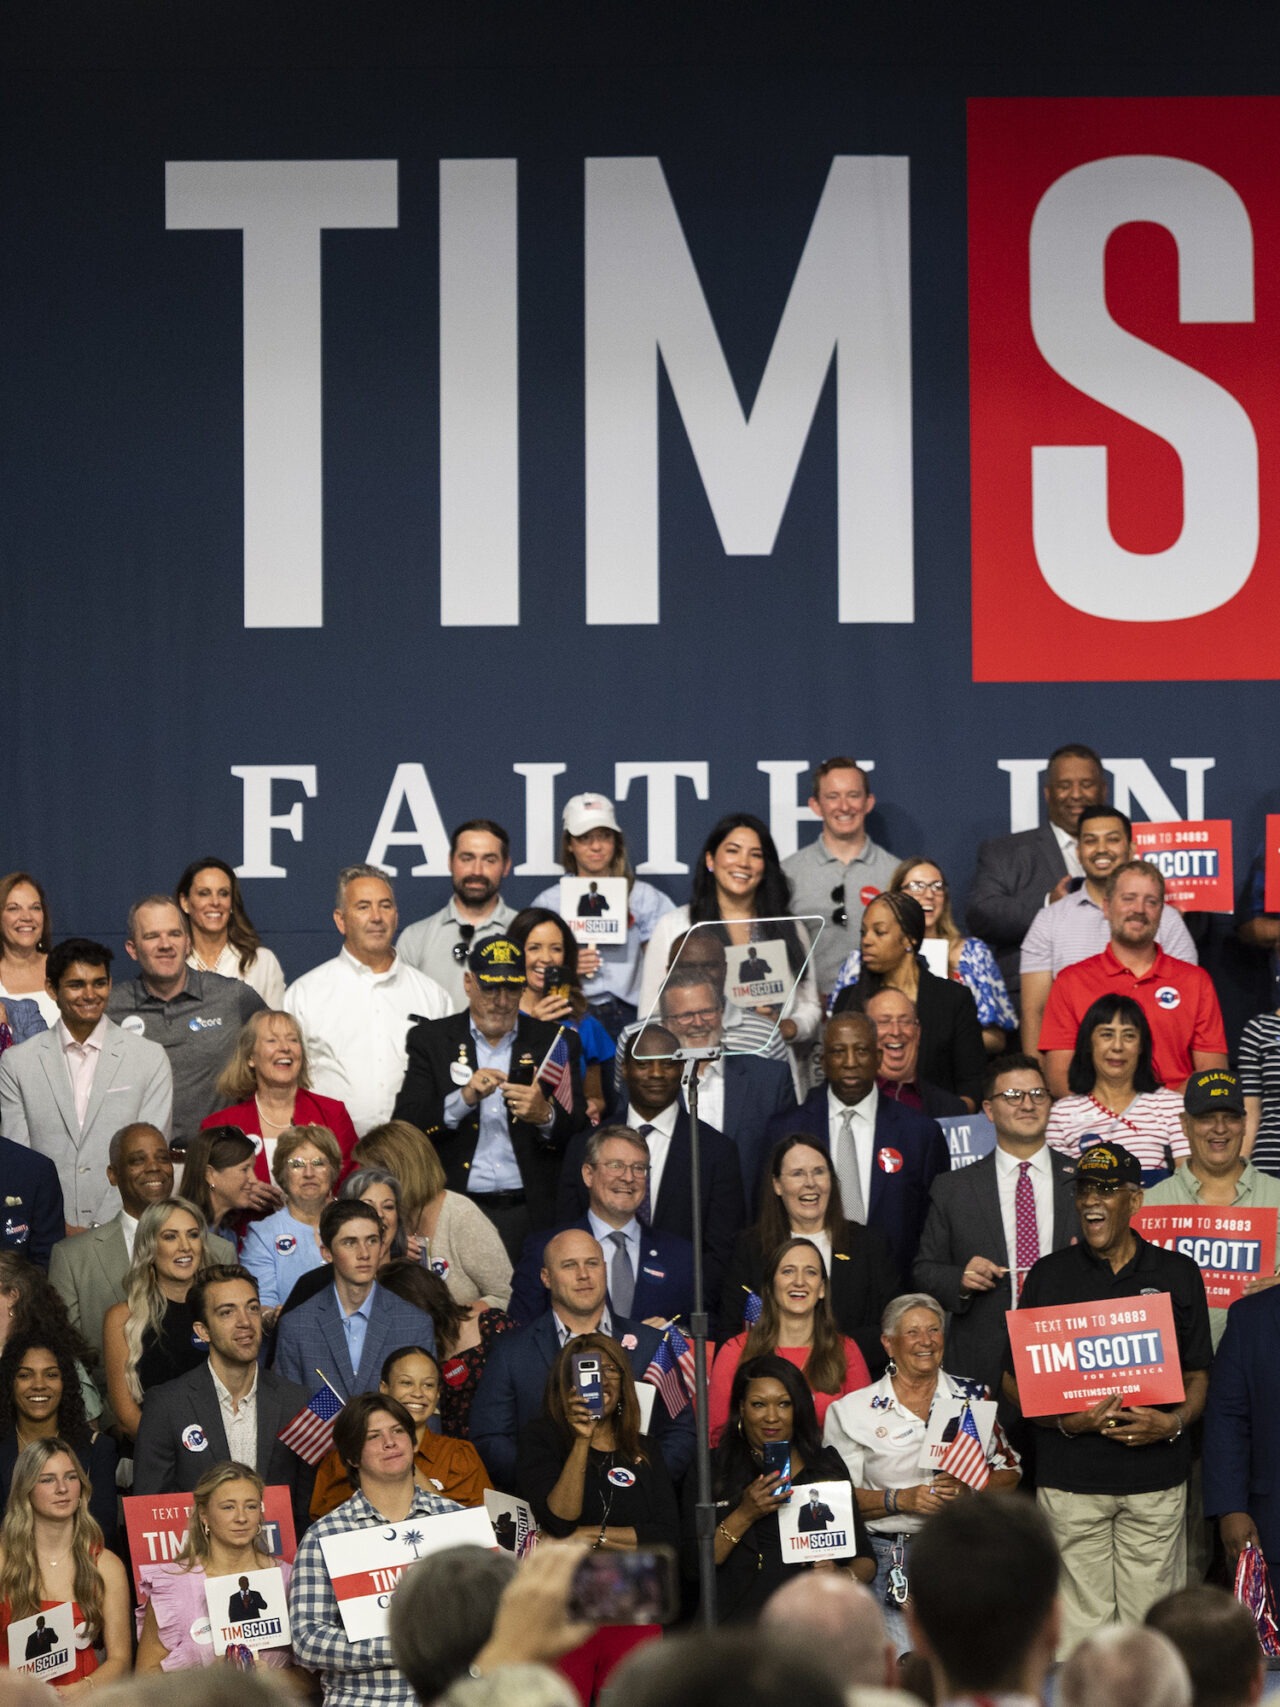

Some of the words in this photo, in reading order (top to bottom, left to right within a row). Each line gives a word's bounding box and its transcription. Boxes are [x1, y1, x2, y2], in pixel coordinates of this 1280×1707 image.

[165, 155, 914, 628] TIM
[231, 758, 875, 878] FAITH
[1136, 834, 1156, 845] TIM
[1160, 832, 1172, 844] TO
[586, 919, 618, 933] SCOTT
[732, 984, 750, 998] TIM
[751, 980, 784, 997] SCOTT
[1141, 1217, 1167, 1230] TEXT
[1171, 1217, 1193, 1229] TIM
[1197, 1218, 1211, 1229] TO
[1215, 1219, 1252, 1232] 34883
[1205, 1272, 1257, 1281] AMERICA
[1034, 1320, 1062, 1333] TEXT
[1066, 1317, 1088, 1330] TIM
[1091, 1315, 1107, 1327] TO
[1110, 1310, 1147, 1326] 34883
[1025, 1341, 1076, 1375] TIM
[1077, 1332, 1159, 1370] SCOTT
[1083, 1372, 1105, 1381] FOR
[1111, 1367, 1164, 1378] AMERICA
[1063, 1384, 1141, 1400] VOTETIMSCOTT.COM
[152, 1507, 180, 1521] TEXT
[790, 1535, 809, 1550] TIM
[810, 1531, 846, 1550] SCOTT
[221, 1626, 242, 1641] TIM
[243, 1619, 280, 1638] SCOTT
[36, 1649, 68, 1673] SCOTT
